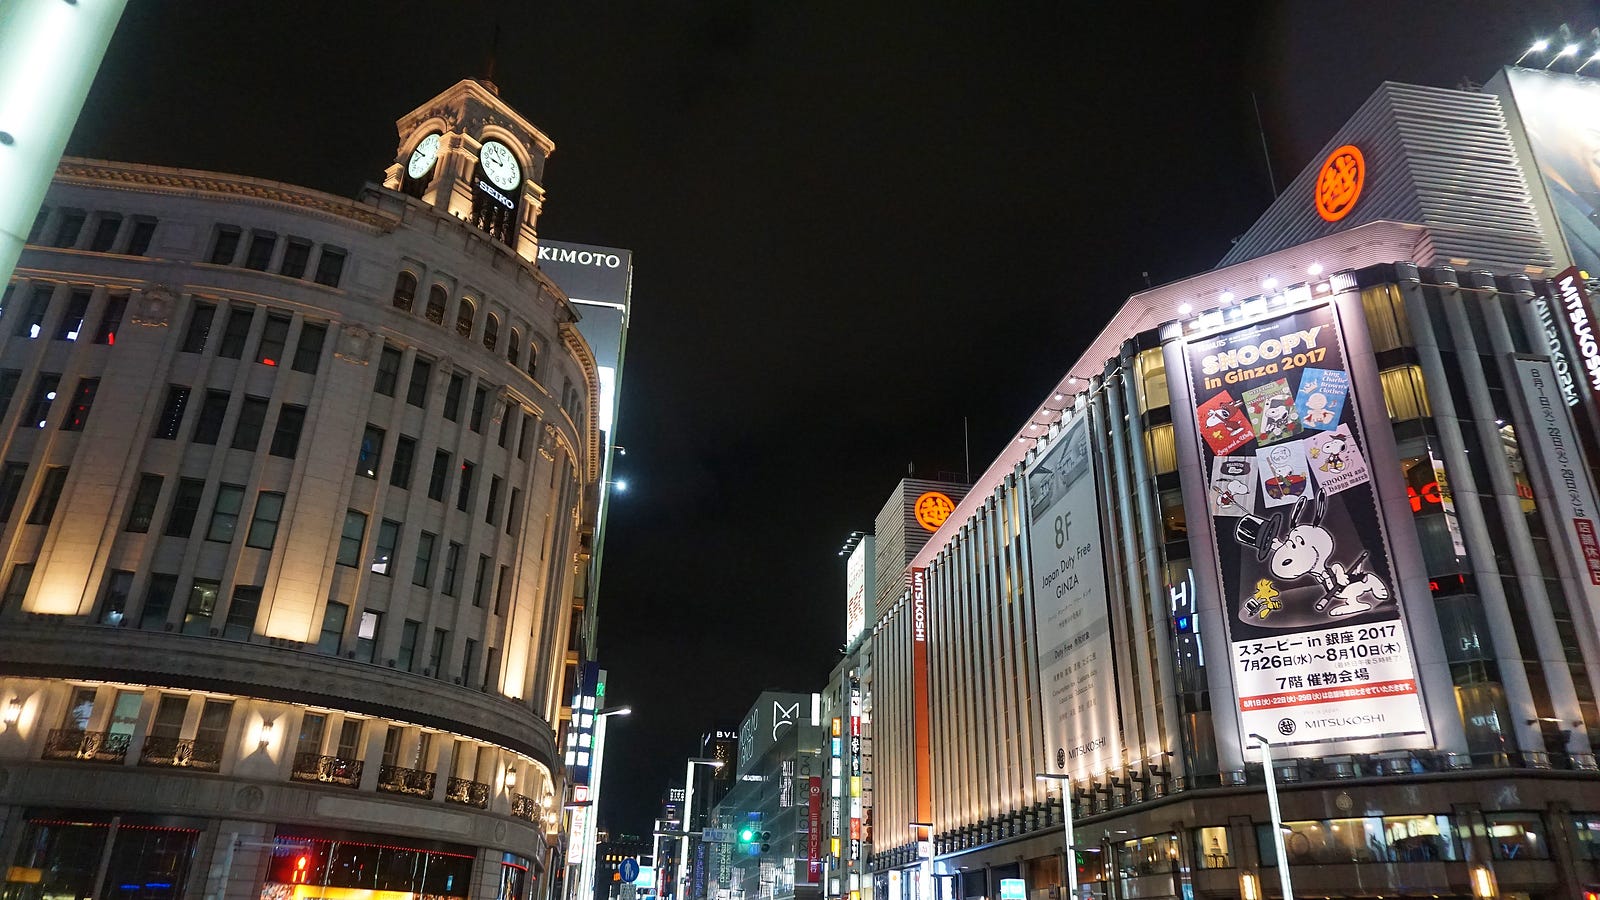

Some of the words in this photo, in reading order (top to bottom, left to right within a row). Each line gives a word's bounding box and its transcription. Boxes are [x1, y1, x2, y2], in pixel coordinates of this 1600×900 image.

[480, 181, 515, 209] SEIKO
[1202, 326, 1322, 375] SNOOPY
[1204, 376, 1222, 390] in
[1224, 362, 1278, 384] Ginza
[1282, 347, 1327, 371] 2017
[1054, 511, 1072, 550] 8F
[1041, 568, 1060, 589] Japan
[1060, 554, 1075, 573] Duty
[1077, 542, 1092, 560] Free
[1056, 574, 1079, 599] GINZA
[914, 572, 925, 642] MITSUKOSHI
[1307, 636, 1322, 648] in
[1325, 631, 1355, 646] 銀座
[1358, 625, 1395, 641] 2017
[1275, 675, 1303, 690] 7階
[1307, 667, 1370, 687] 催物会場
[1304, 714, 1385, 729] MITSUKOSHI
[716, 731, 738, 739] BVL
[1068, 736, 1106, 760] MITSUKOSHI
